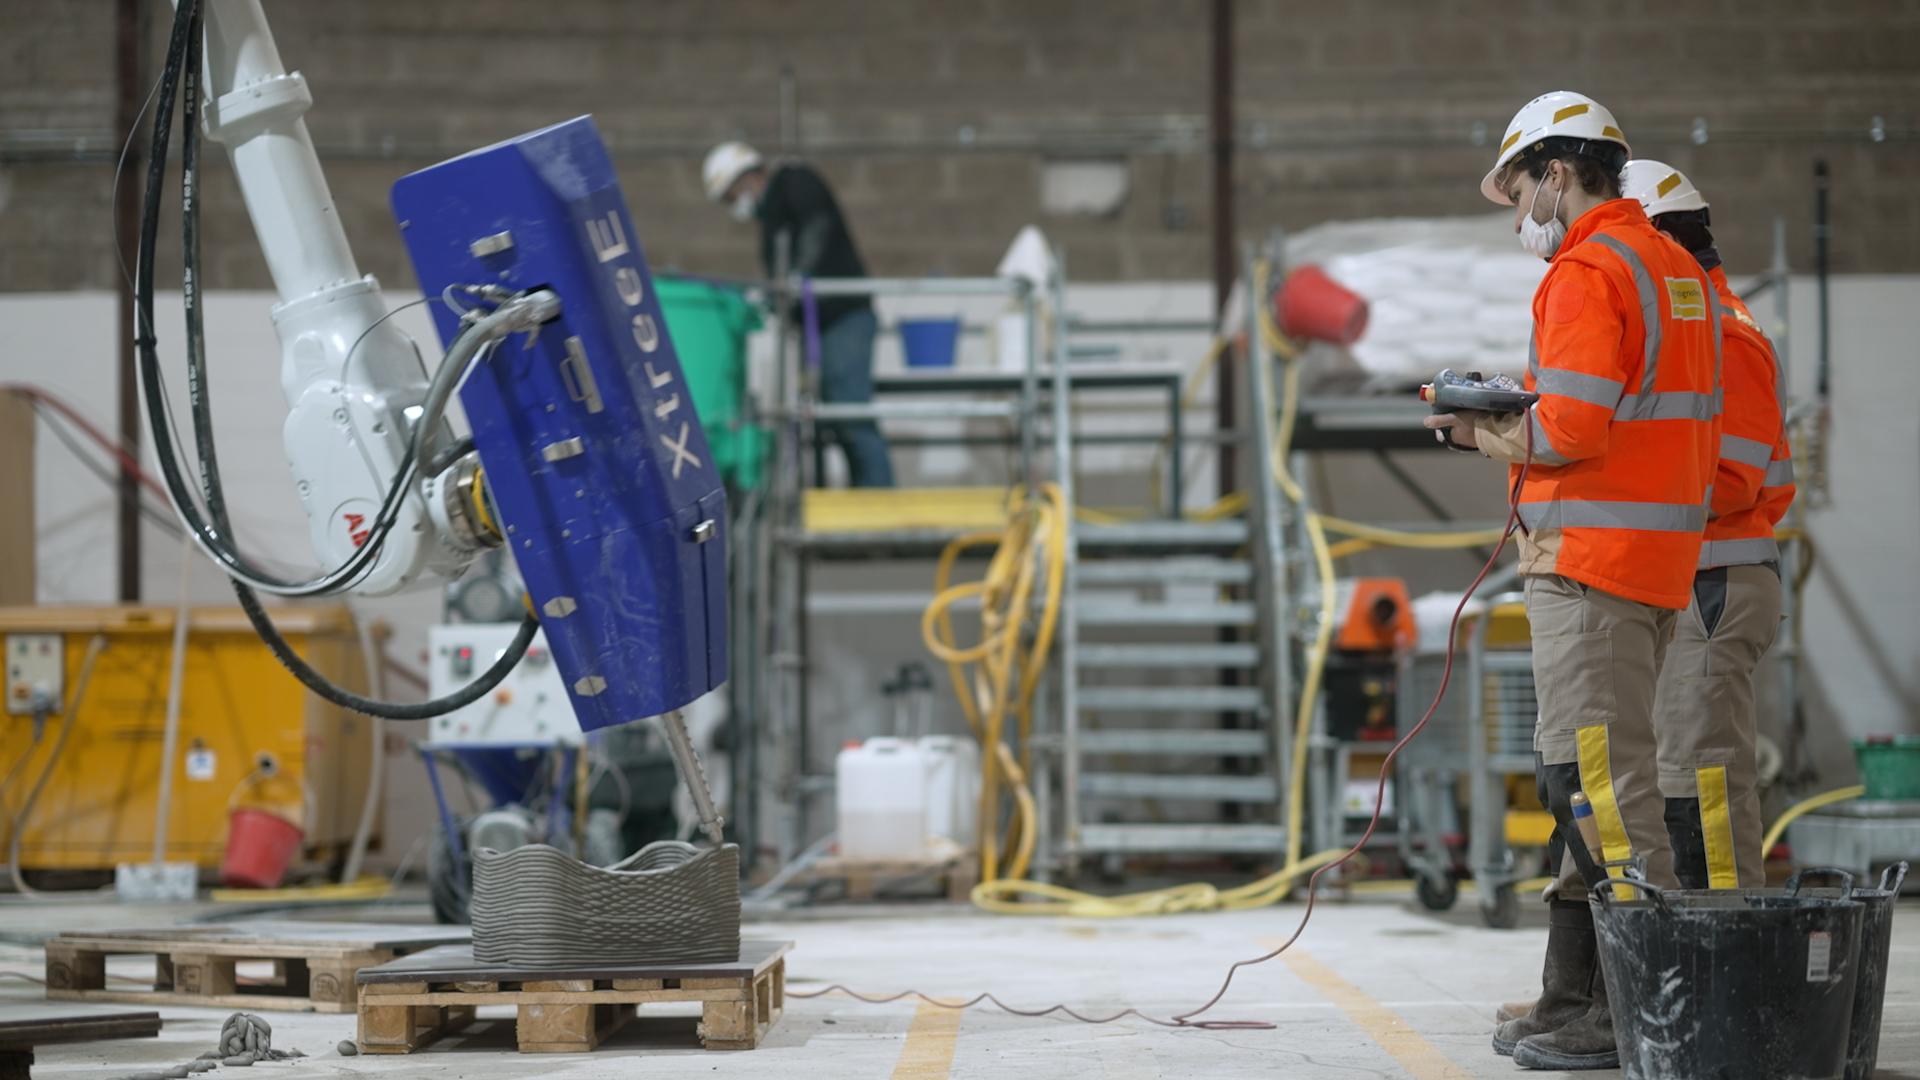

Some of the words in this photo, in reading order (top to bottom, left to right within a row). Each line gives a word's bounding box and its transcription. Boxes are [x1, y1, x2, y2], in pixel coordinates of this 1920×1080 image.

[186, 72, 194, 88] Bar
[186, 89, 194, 100] 60
[186, 102, 193, 114] PS
[184, 169, 192, 185] Bar
[184, 186, 191, 198] 60
[184, 199, 191, 211] PS
[184, 266, 192, 283] Bar
[185, 284, 192, 295] 60
[185, 297, 193, 309] PS
